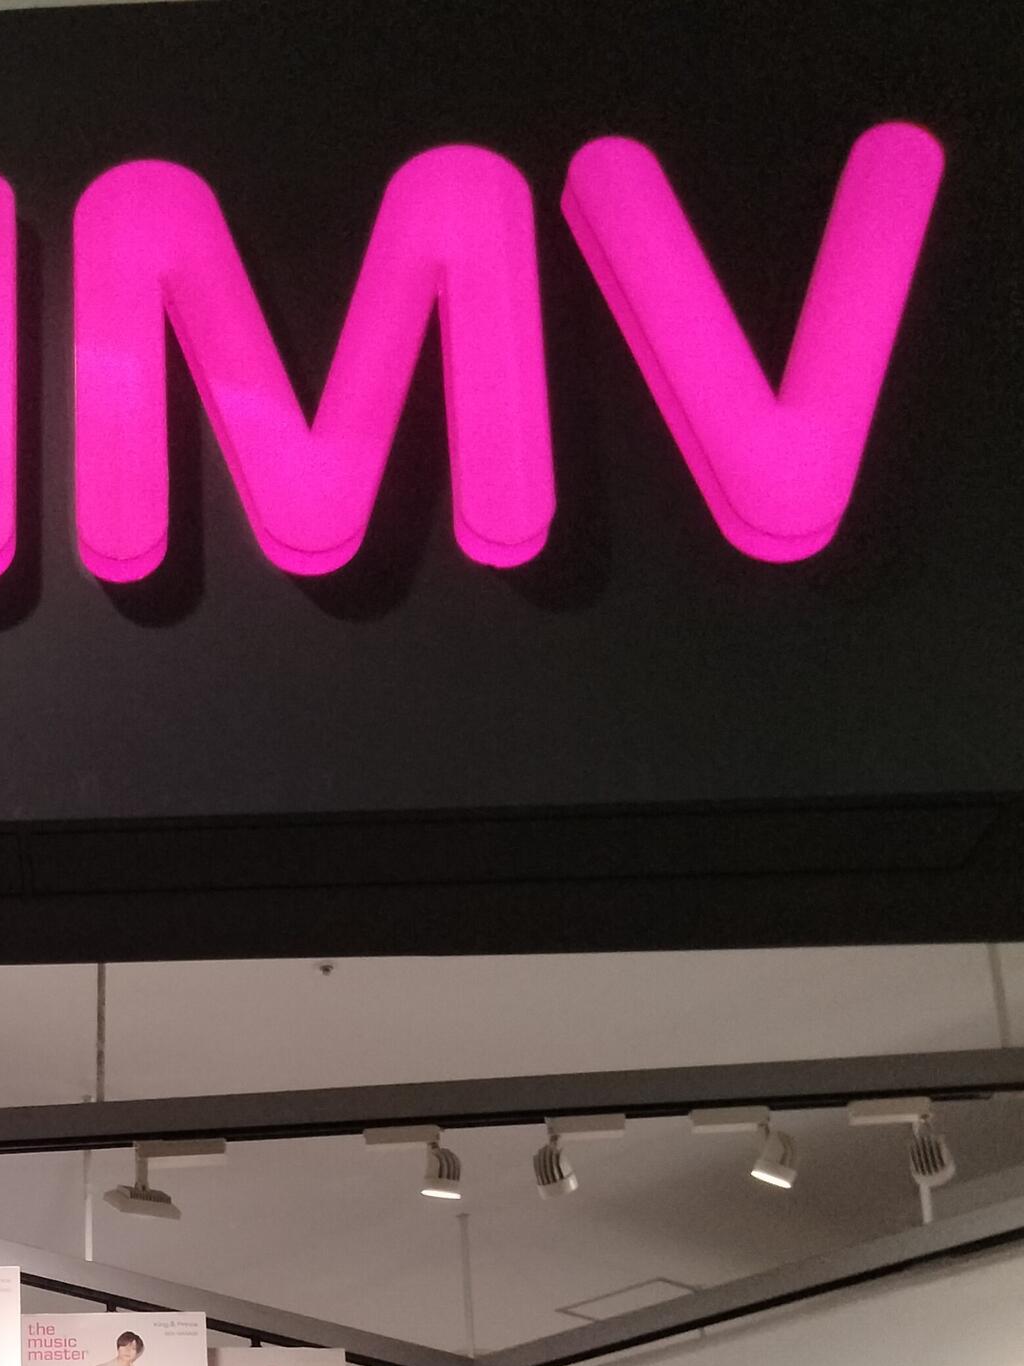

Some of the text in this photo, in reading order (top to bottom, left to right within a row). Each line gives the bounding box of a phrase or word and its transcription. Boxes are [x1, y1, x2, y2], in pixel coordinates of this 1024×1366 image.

[28, 1323, 55, 1335] the
[28, 1336, 77, 1348] music
[28, 1348, 88, 1361] master
